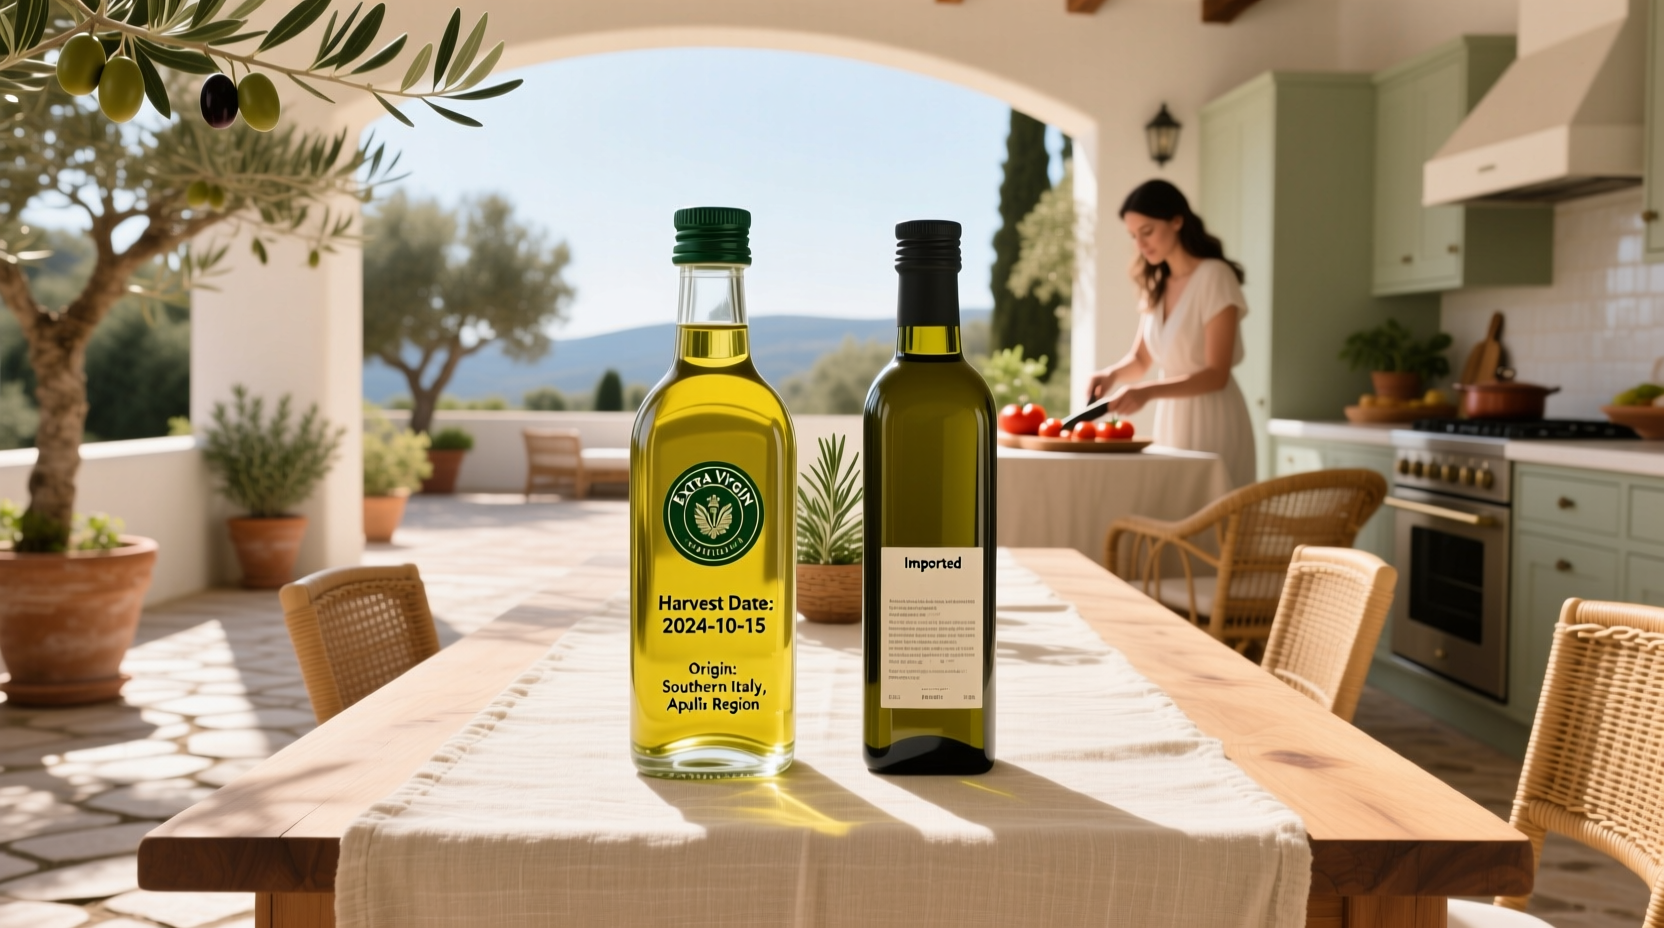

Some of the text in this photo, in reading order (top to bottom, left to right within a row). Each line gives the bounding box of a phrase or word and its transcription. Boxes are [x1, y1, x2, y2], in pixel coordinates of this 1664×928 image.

[904, 556, 962, 572] Imported
[658, 595, 774, 611] Harvest Date:
[662, 617, 766, 634] 2024-10-15
[688, 661, 737, 679] Origin:
[662, 678, 767, 697] Southern Italy,
[712, 696, 760, 714] Region
